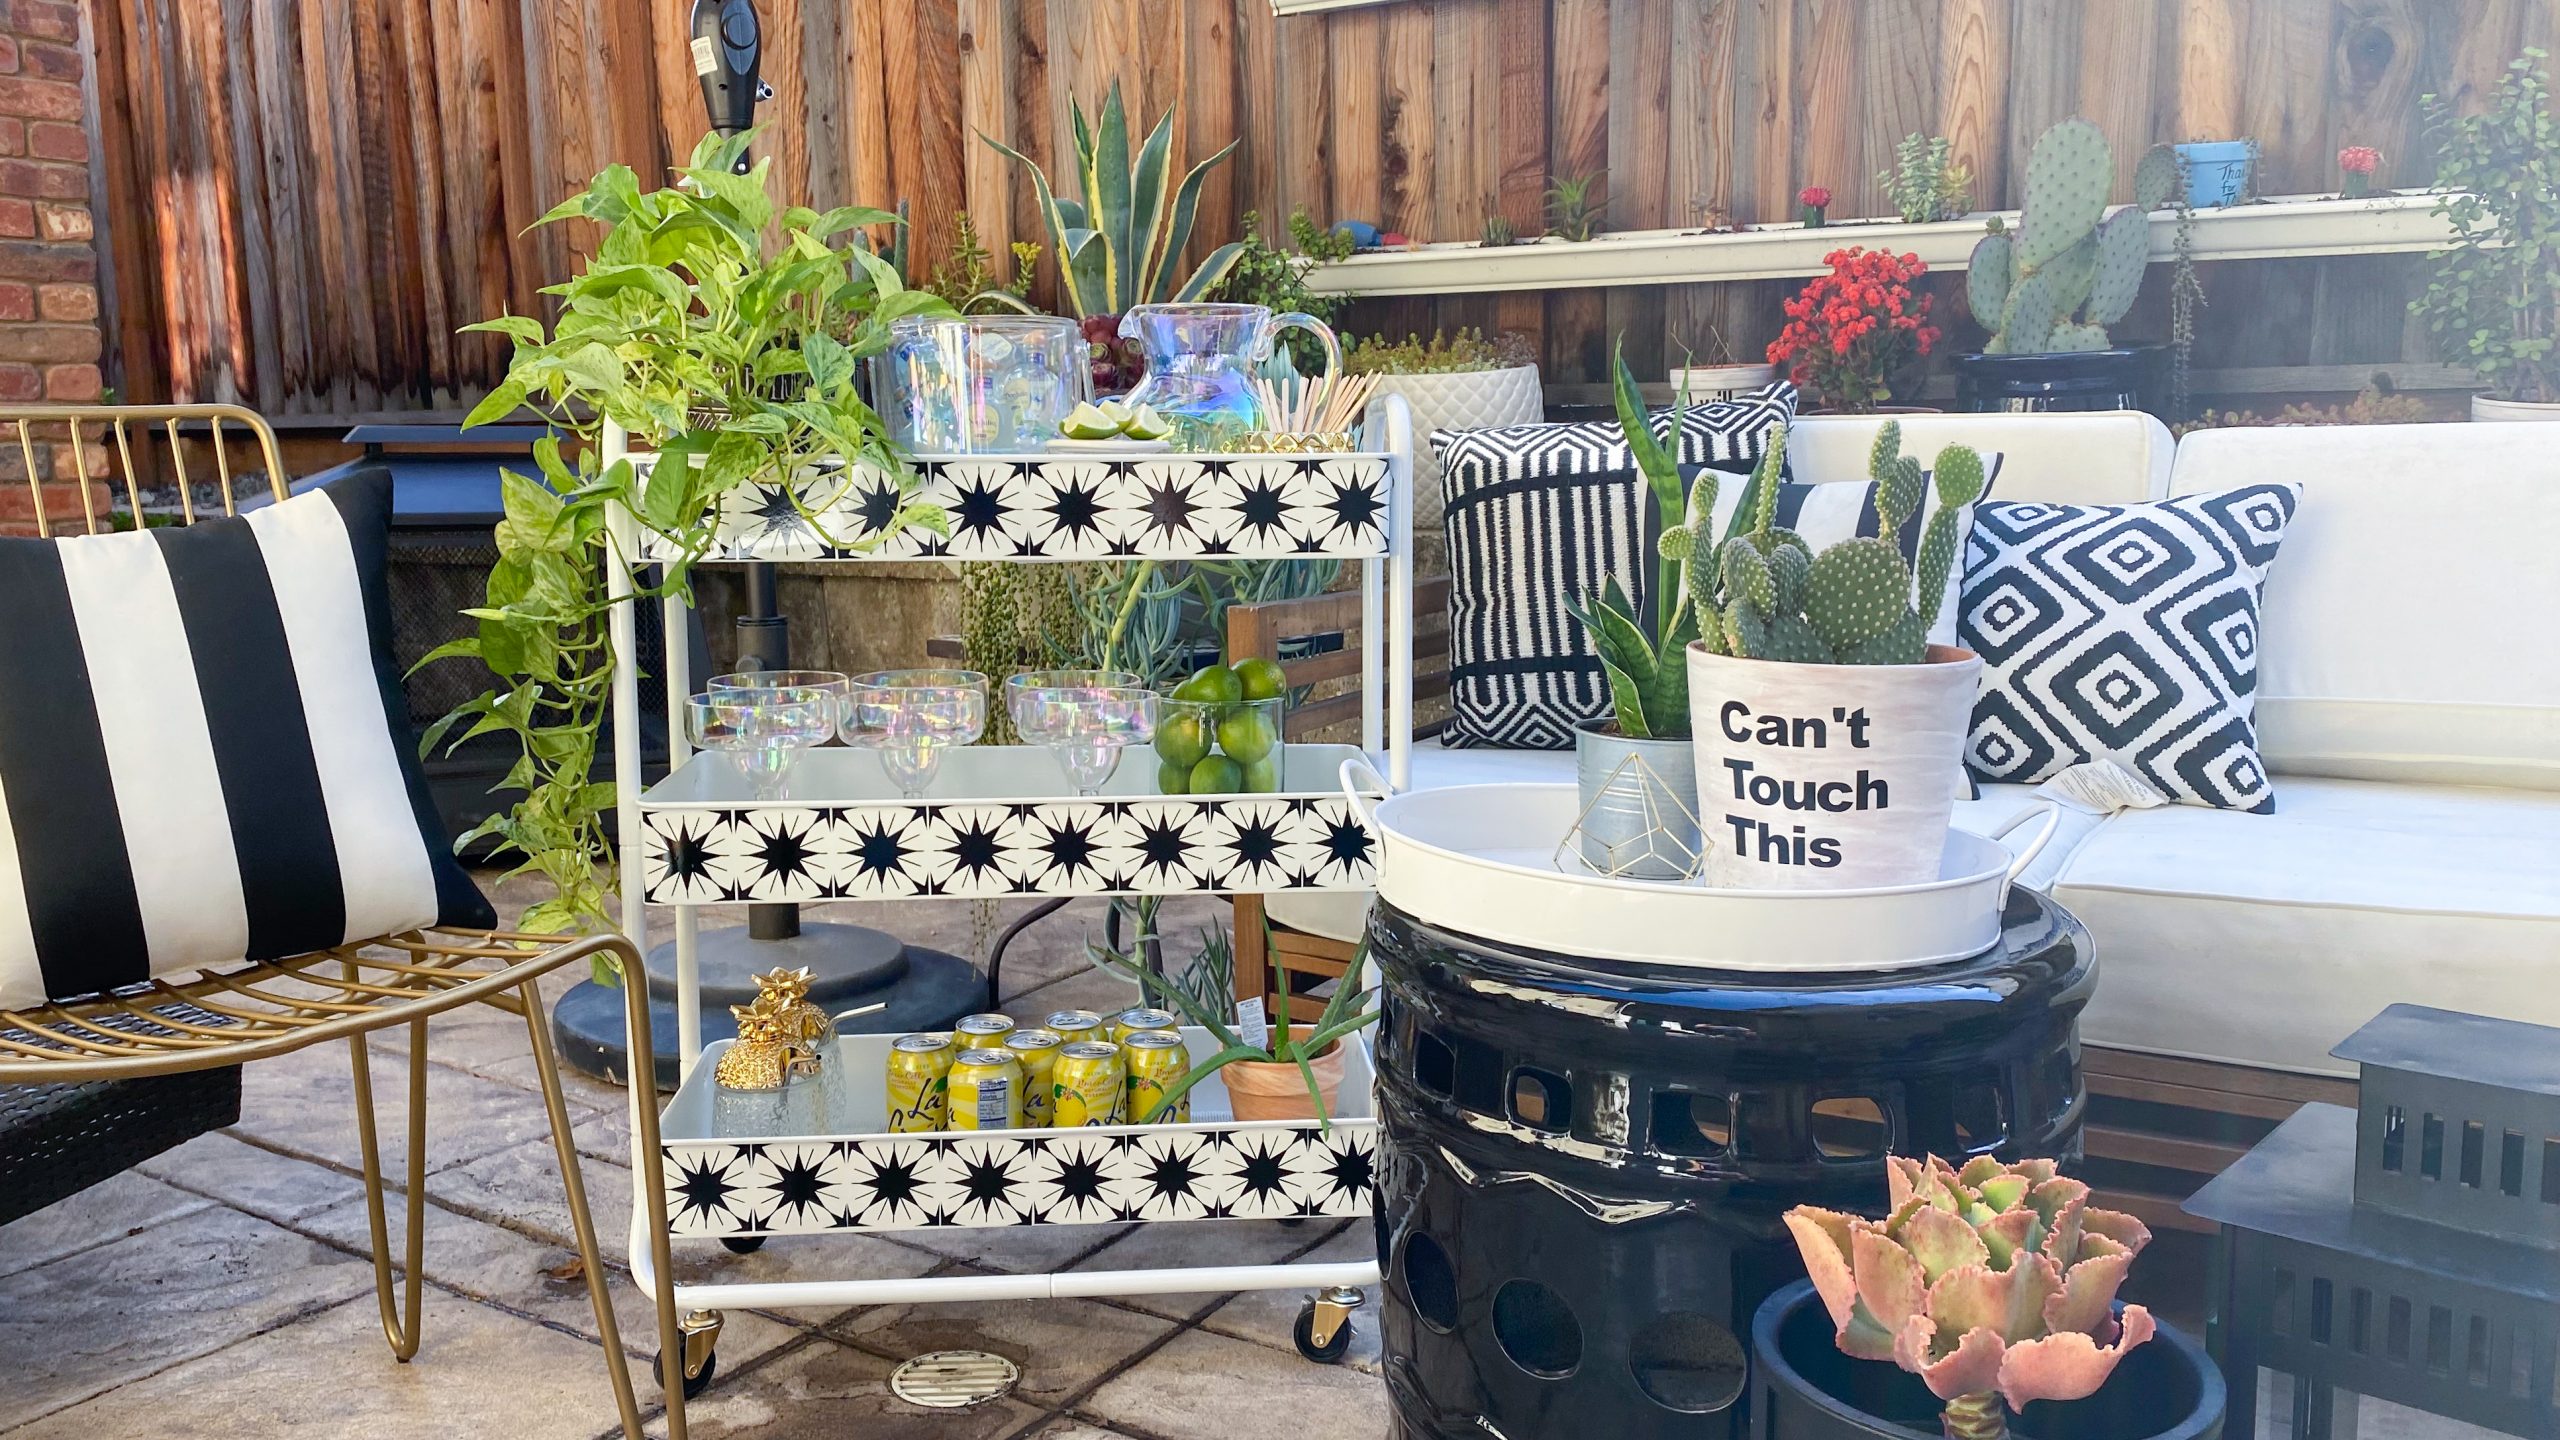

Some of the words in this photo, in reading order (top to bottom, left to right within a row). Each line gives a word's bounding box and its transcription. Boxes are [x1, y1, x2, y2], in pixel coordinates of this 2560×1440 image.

[1720, 700, 1871, 749] Can't
[1723, 757, 1889, 813] Touch
[1725, 813, 1843, 868] This
[908, 1077, 943, 1121] La
